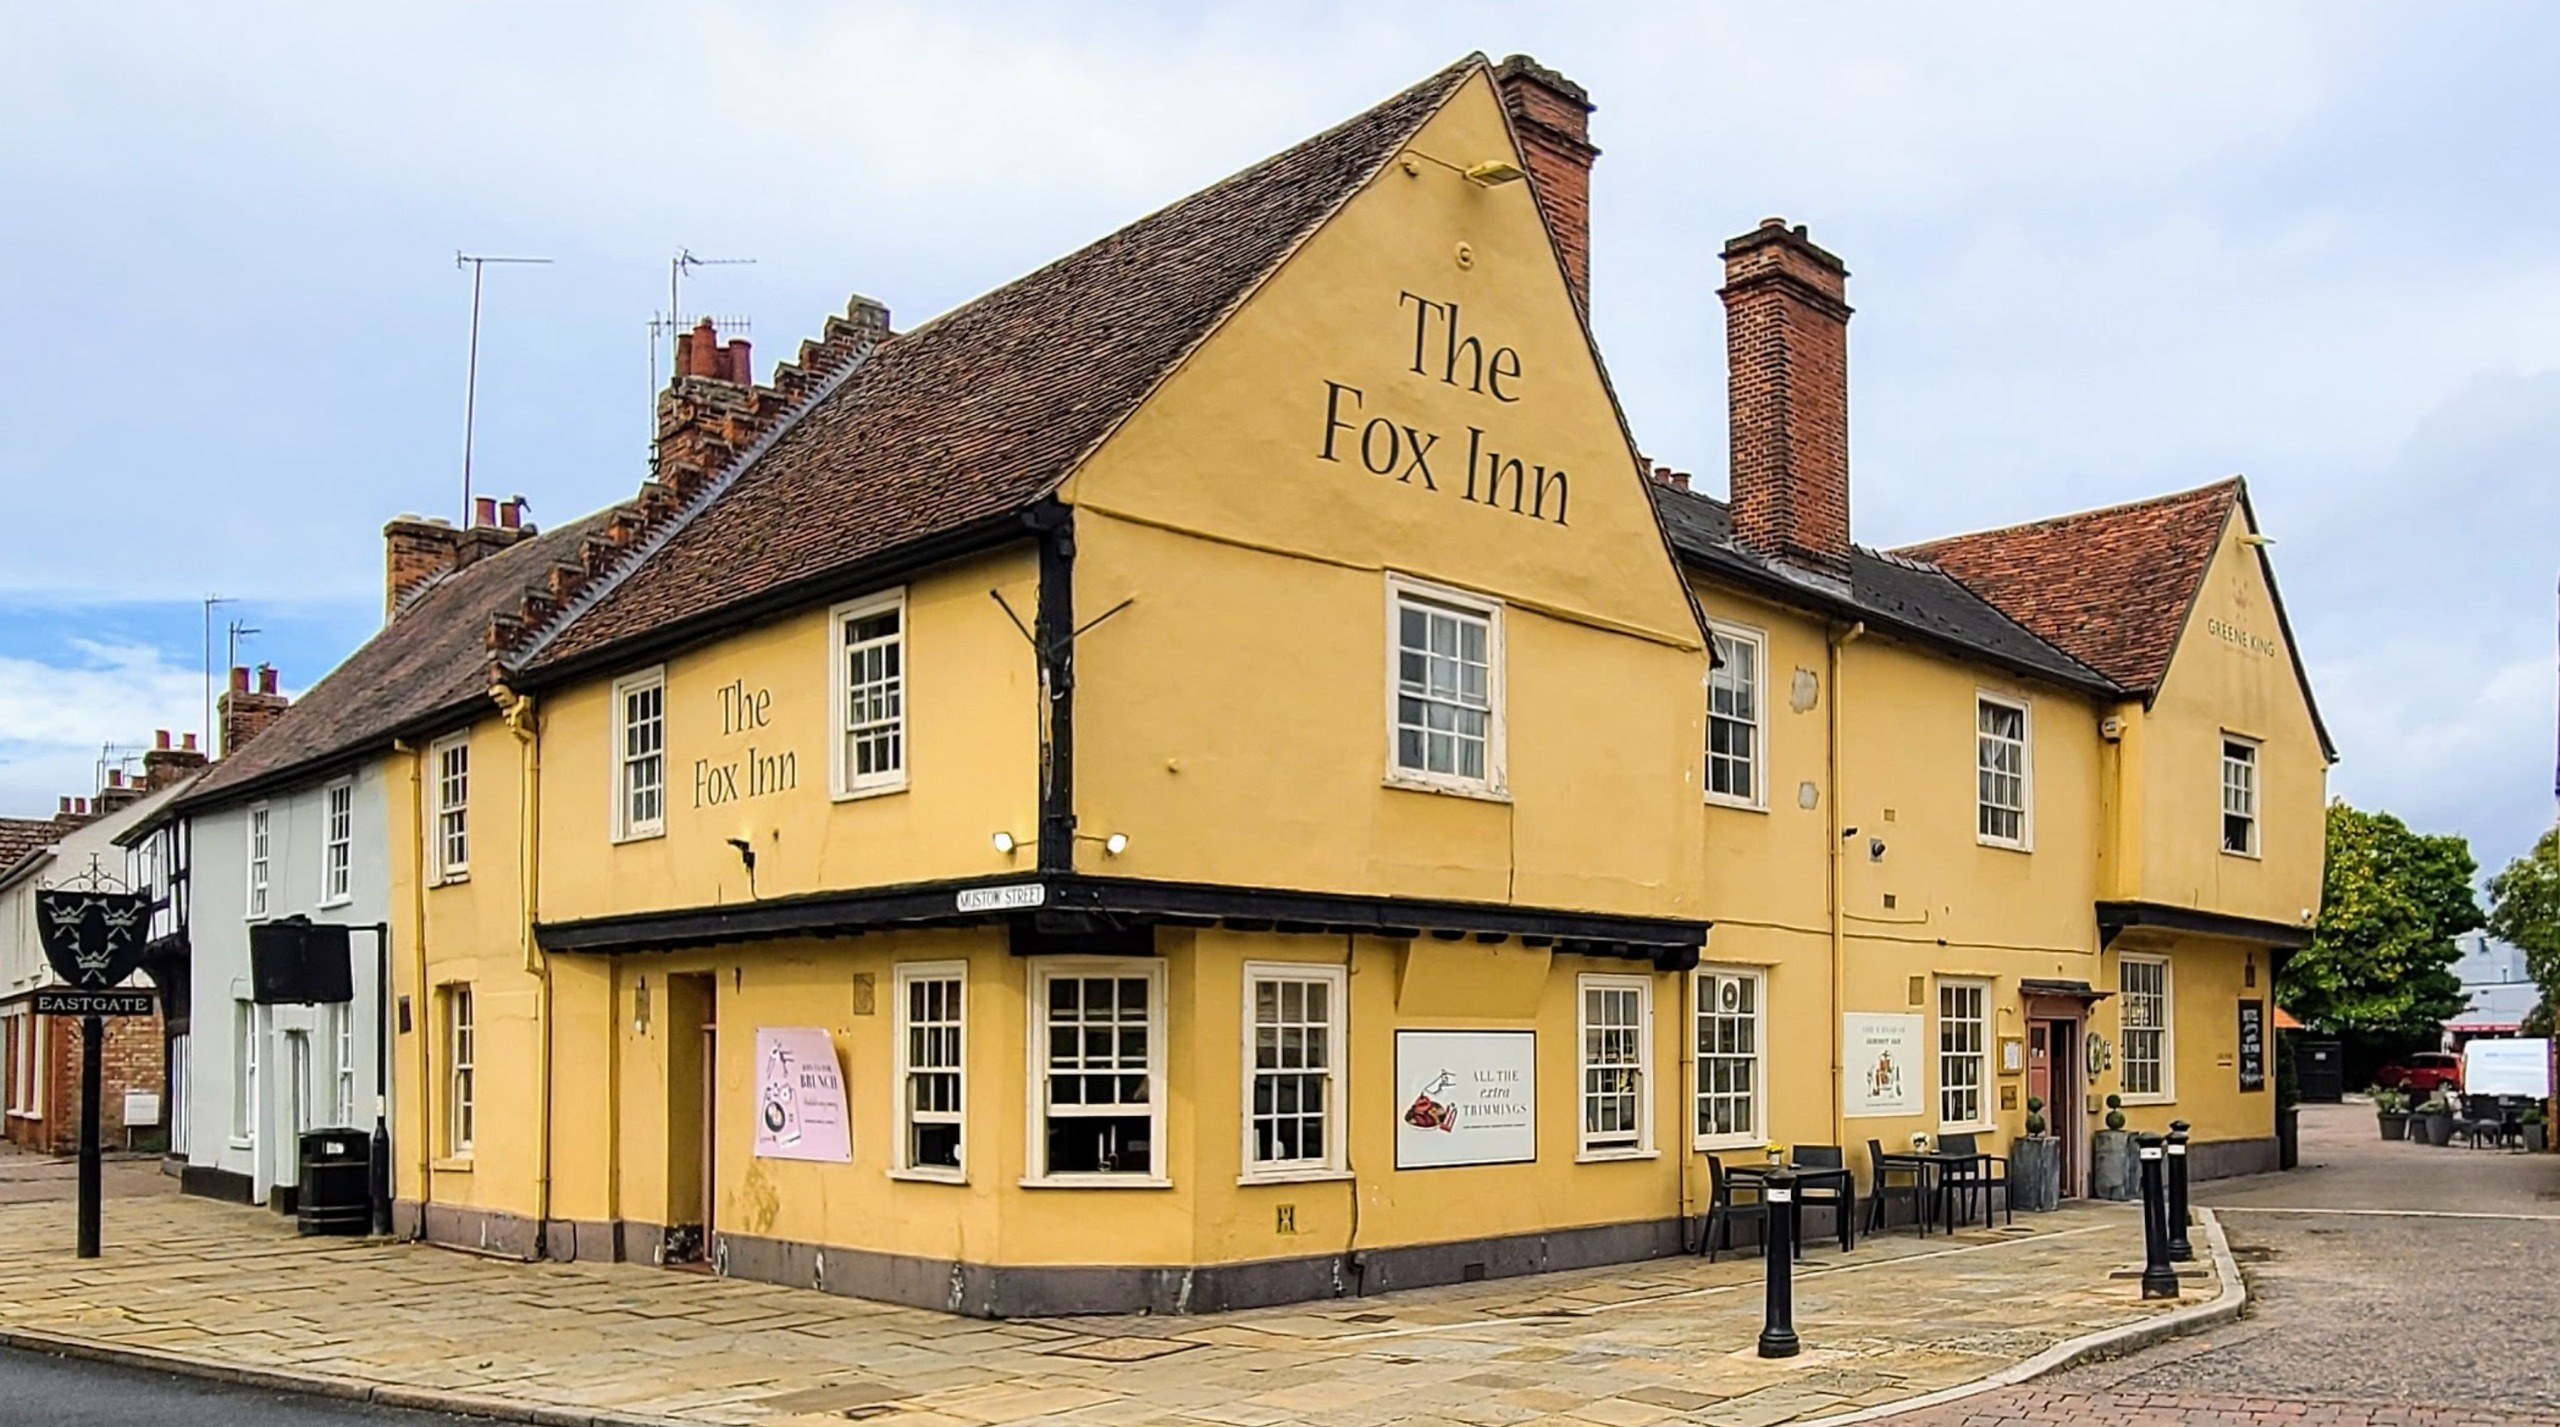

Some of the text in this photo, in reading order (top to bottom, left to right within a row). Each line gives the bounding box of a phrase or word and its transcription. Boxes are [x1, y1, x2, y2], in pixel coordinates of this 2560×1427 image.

[1399, 290, 1521, 403] The
[1316, 379, 1569, 528] Fox Inn
[2208, 618, 2275, 657] GREENE KING
[717, 678, 771, 736] The
[693, 747, 797, 809] Fox Inn
[1005, 886, 1041, 905] STREET
[38, 997, 148, 1011] EASTGATE
[800, 1074, 837, 1090] BRUNCH
[1473, 1070, 1519, 1083] ALL THE
[1480, 1087, 1510, 1099] extra
[1463, 1103, 1527, 1117] TRIMMINGS
